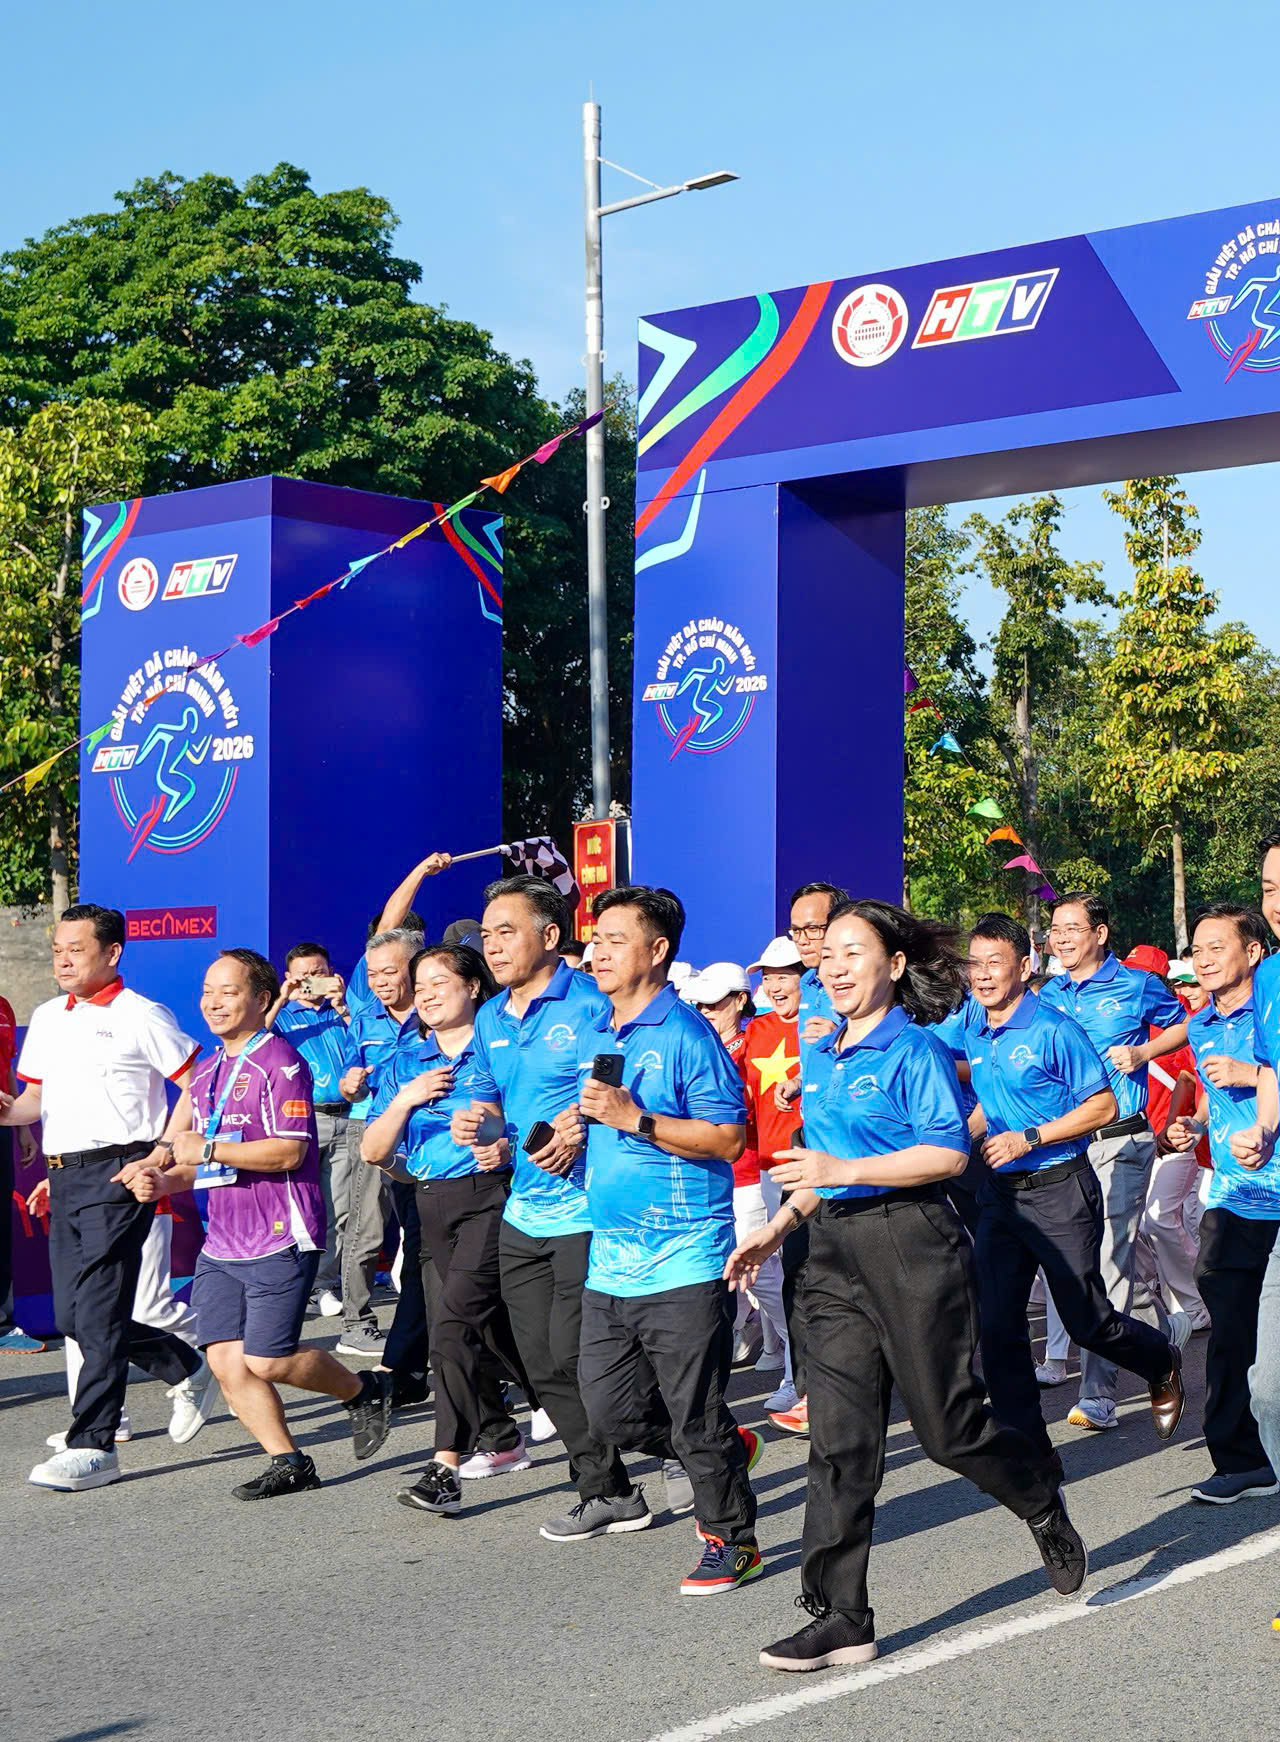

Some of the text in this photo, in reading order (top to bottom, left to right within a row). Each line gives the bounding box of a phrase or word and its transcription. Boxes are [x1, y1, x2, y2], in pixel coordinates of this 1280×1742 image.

[1215, 239, 1238, 267] VIỆT
[1258, 237, 1280, 254] CHÍ
[920, 279, 1048, 338] HTV
[1190, 298, 1230, 317] HTV
[166, 561, 233, 594] HTV
[735, 675, 768, 693] 2026
[94, 748, 136, 769] HTV
[212, 735, 254, 761] 2026
